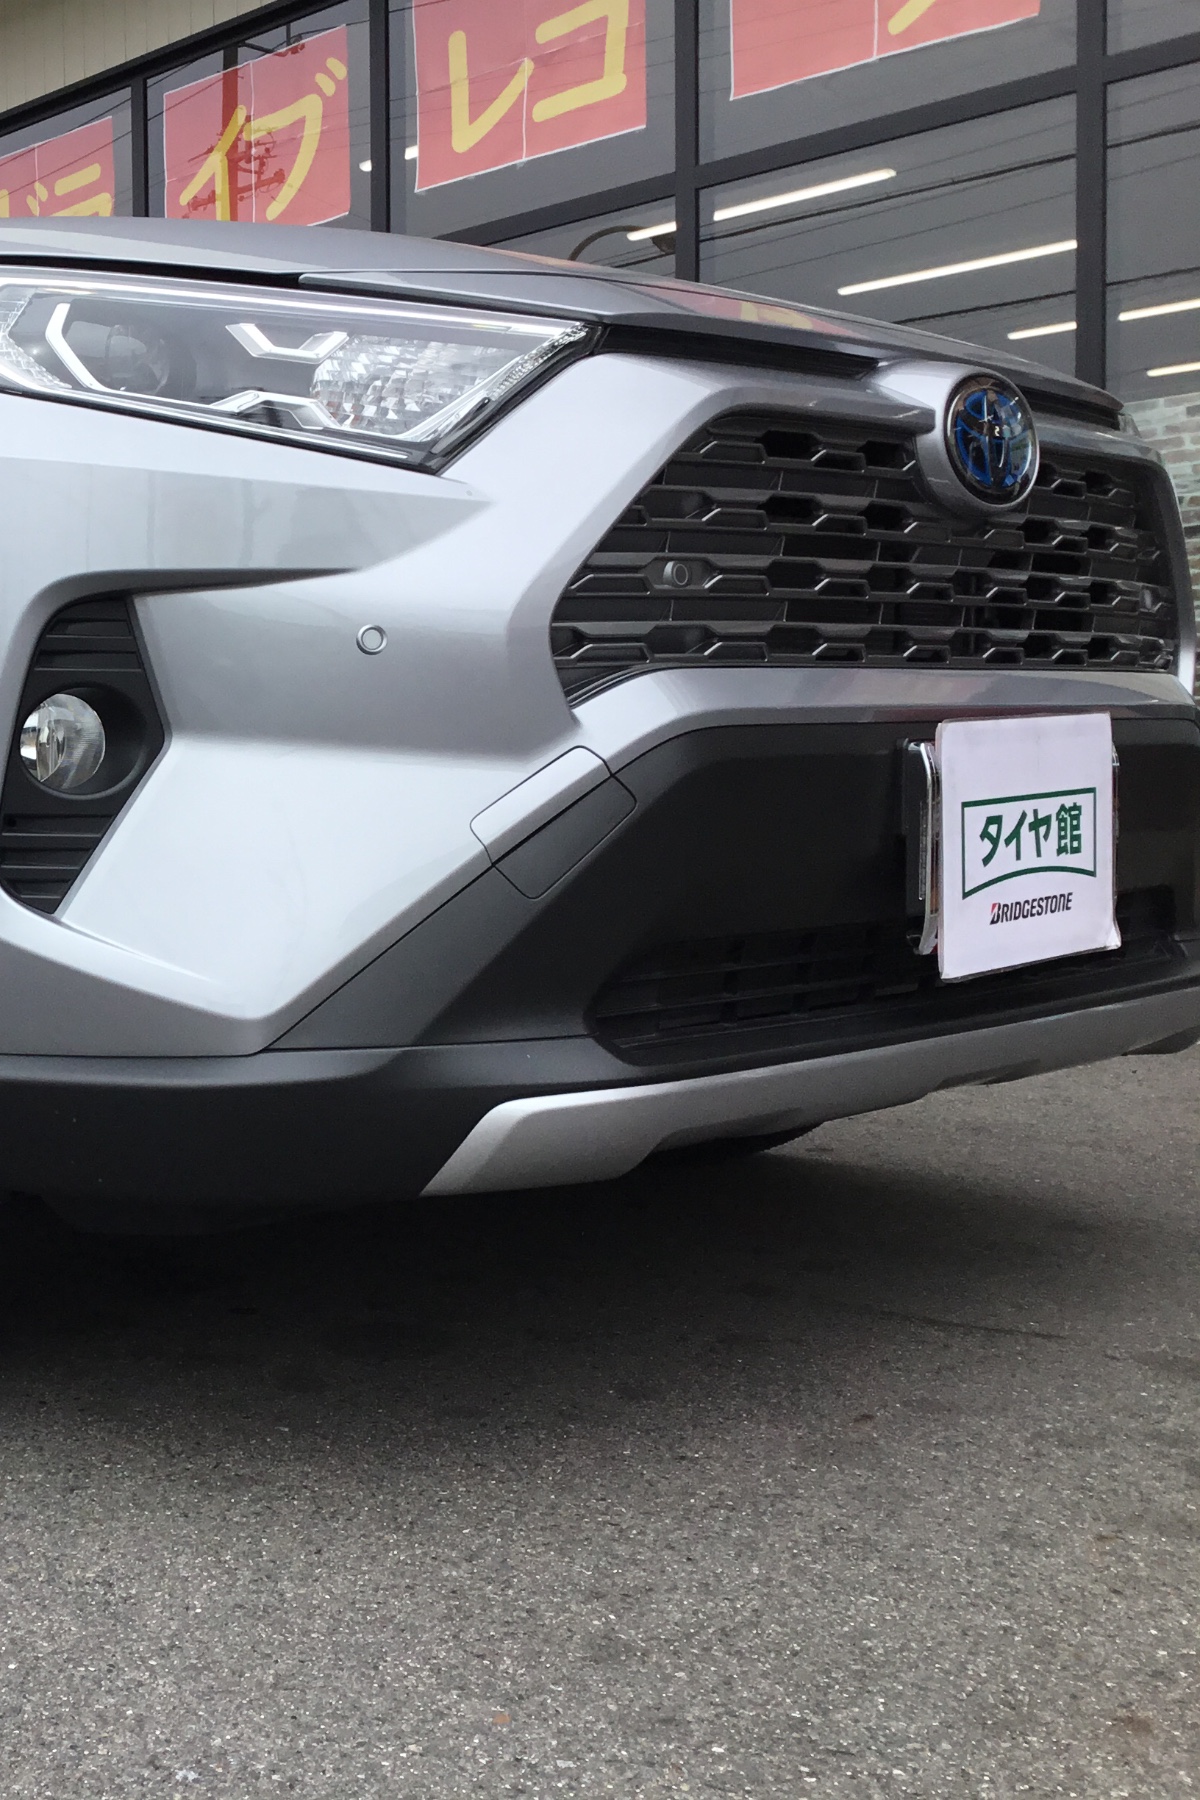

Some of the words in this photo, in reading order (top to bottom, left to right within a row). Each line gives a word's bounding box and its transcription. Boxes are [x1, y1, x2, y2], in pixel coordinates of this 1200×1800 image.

[979, 802, 1082, 868] タイヤ館
[990, 892, 1073, 925] BRIDGESTONE
